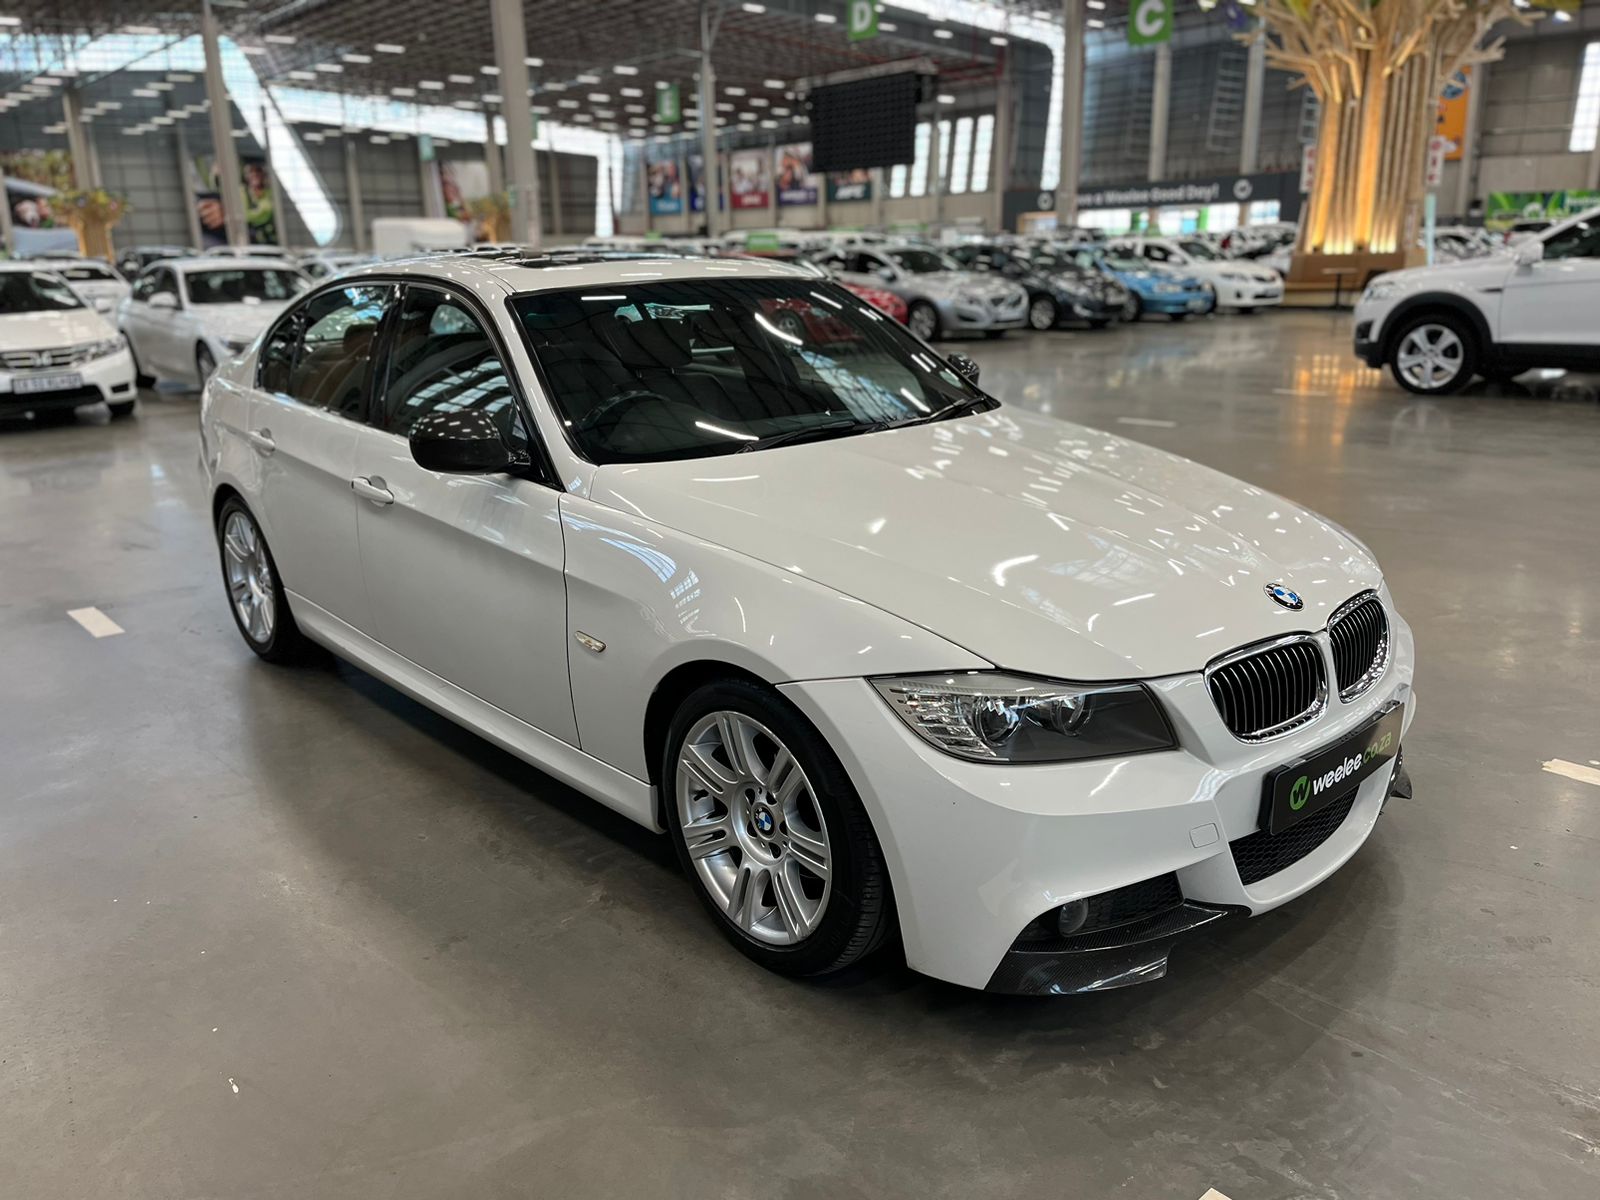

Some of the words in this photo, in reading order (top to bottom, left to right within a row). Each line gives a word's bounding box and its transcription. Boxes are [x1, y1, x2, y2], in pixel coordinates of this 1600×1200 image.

[852, 1, 872, 32] D
[1136, 0, 1166, 37] C
[1151, 184, 1185, 200] Good
[1187, 182, 1220, 203] Day!
